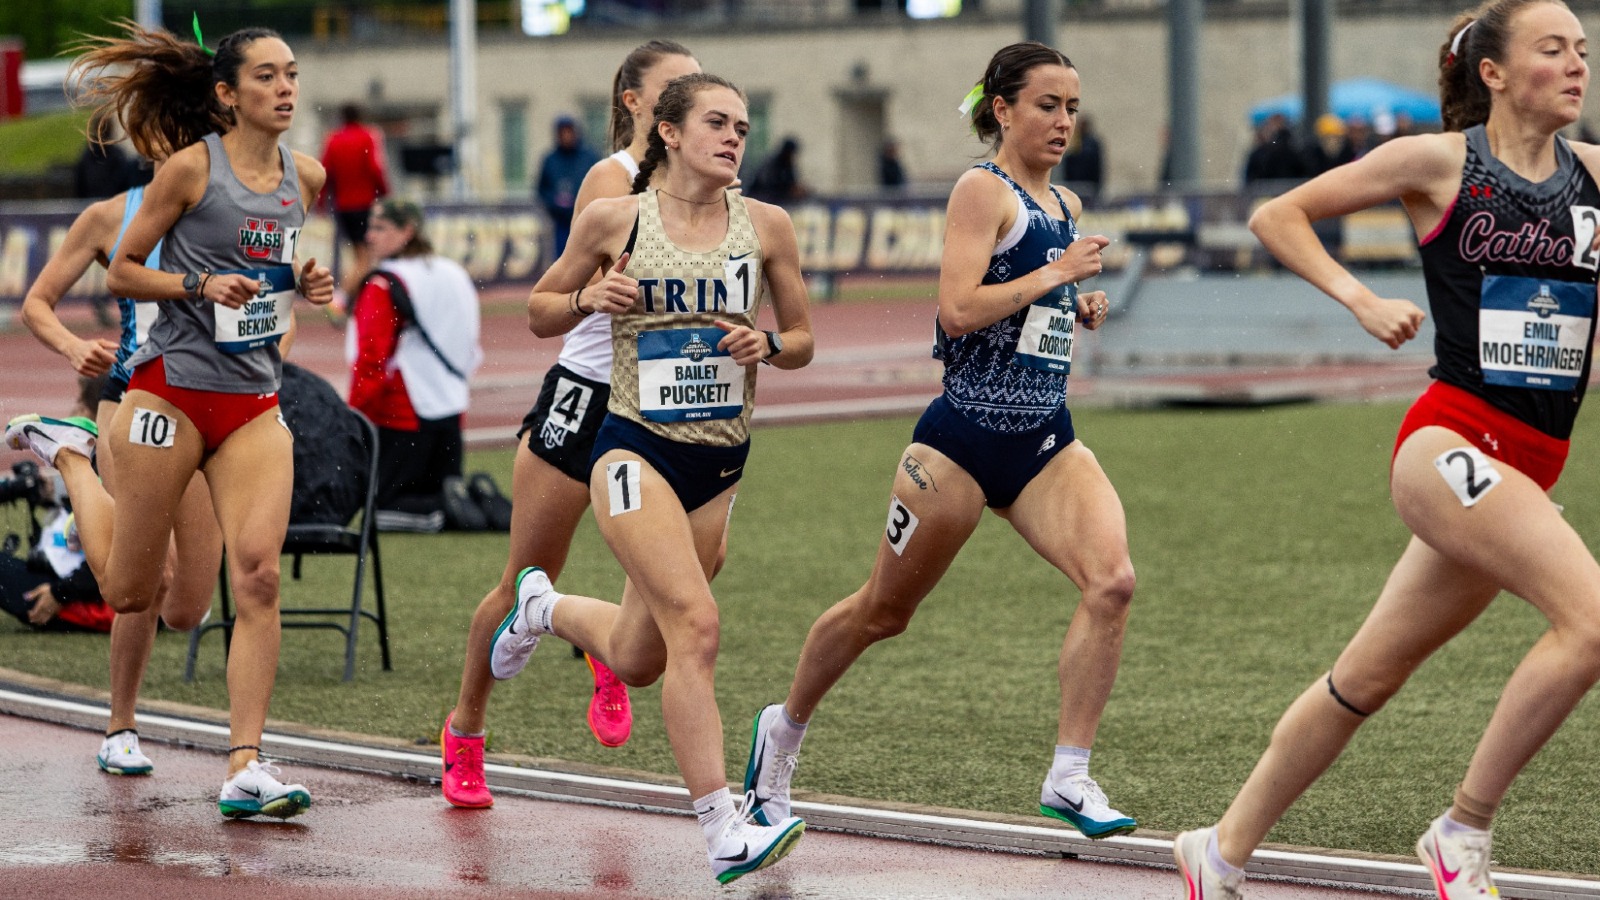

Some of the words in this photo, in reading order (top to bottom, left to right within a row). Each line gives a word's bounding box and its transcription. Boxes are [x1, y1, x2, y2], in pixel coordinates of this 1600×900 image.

[239, 228, 282, 249] WASH
[290, 229, 301, 261] 1
[735, 262, 749, 311] 1
[244, 300, 276, 315] SOPHIE
[238, 315, 278, 337] BEKINS
[1524, 321, 1561, 341] EMILY
[1482, 341, 1584, 371] MOEHRINGER
[675, 364, 719, 381] BAILEY
[553, 385, 583, 427] 4
[660, 383, 731, 405] PUCKETT
[140, 411, 169, 446] 10
[614, 463, 631, 510] 1
[1445, 450, 1493, 500] 2
[886, 504, 911, 546] 3
